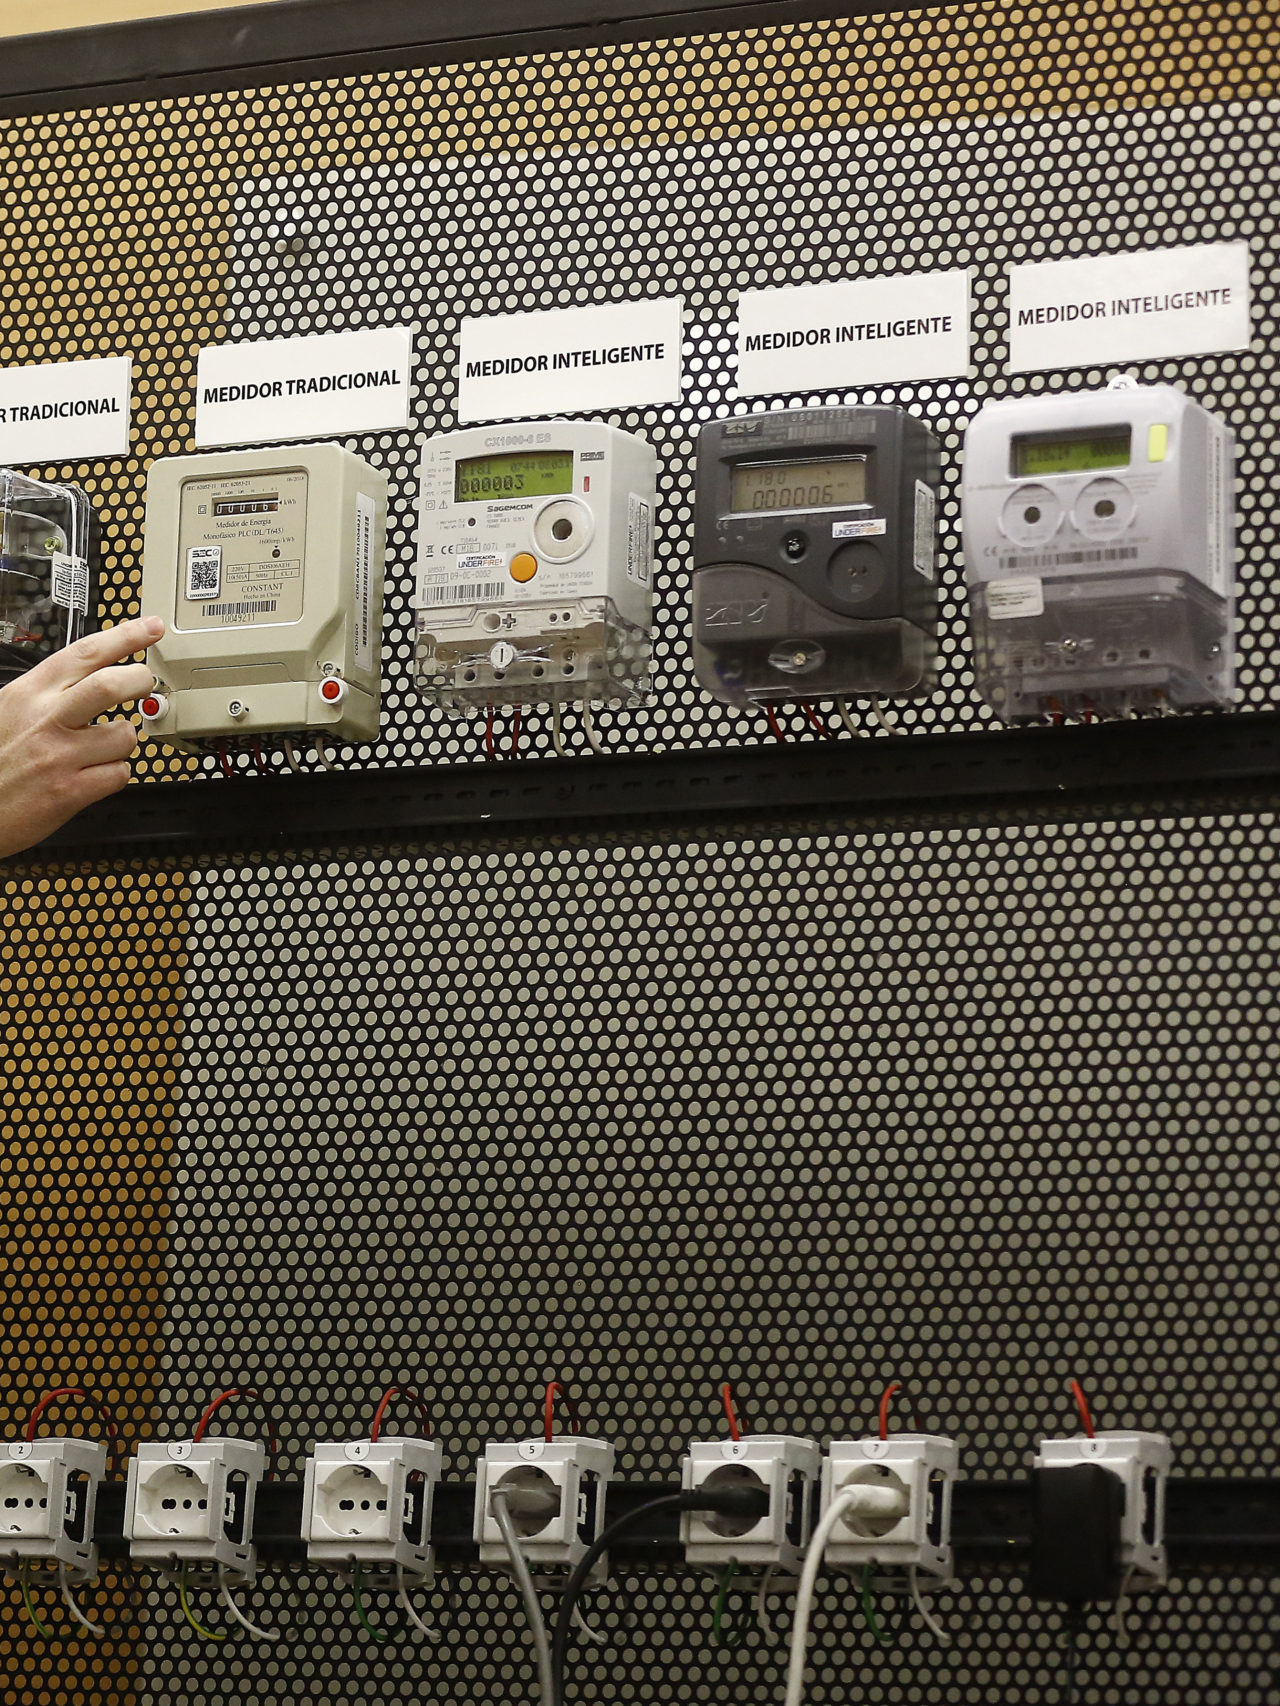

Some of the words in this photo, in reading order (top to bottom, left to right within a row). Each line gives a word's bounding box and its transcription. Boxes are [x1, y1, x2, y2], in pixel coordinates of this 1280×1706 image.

[1018, 302, 1106, 326] MEDIDOR
[1112, 288, 1231, 316] INTELIGENTE
[745, 328, 831, 352] MEDIDOR
[835, 316, 952, 343] INTELIGENTE
[465, 355, 548, 378] MEDIDOR
[552, 343, 665, 370] INTELIGENTE
[203, 381, 283, 404] MEDIDOR
[285, 369, 401, 396] TRADICIONAL
[9, 397, 120, 422] TRADICIONAL
[460, 474, 525, 494] 000003
[753, 485, 833, 510] 000006
[216, 521, 240, 529] Medidor
[458, 559, 500, 568] UNDERFIRE
[241, 582, 284, 593] CONSTANT
[221, 613, 255, 623] 10049211
[18, 1446, 24, 1454] 2
[177, 1446, 183, 1454] 3
[354, 1447, 360, 1455] 4
[529, 1445, 535, 1454] 5
[732, 1445, 738, 1454] 6
[873, 1444, 879, 1452] 7
